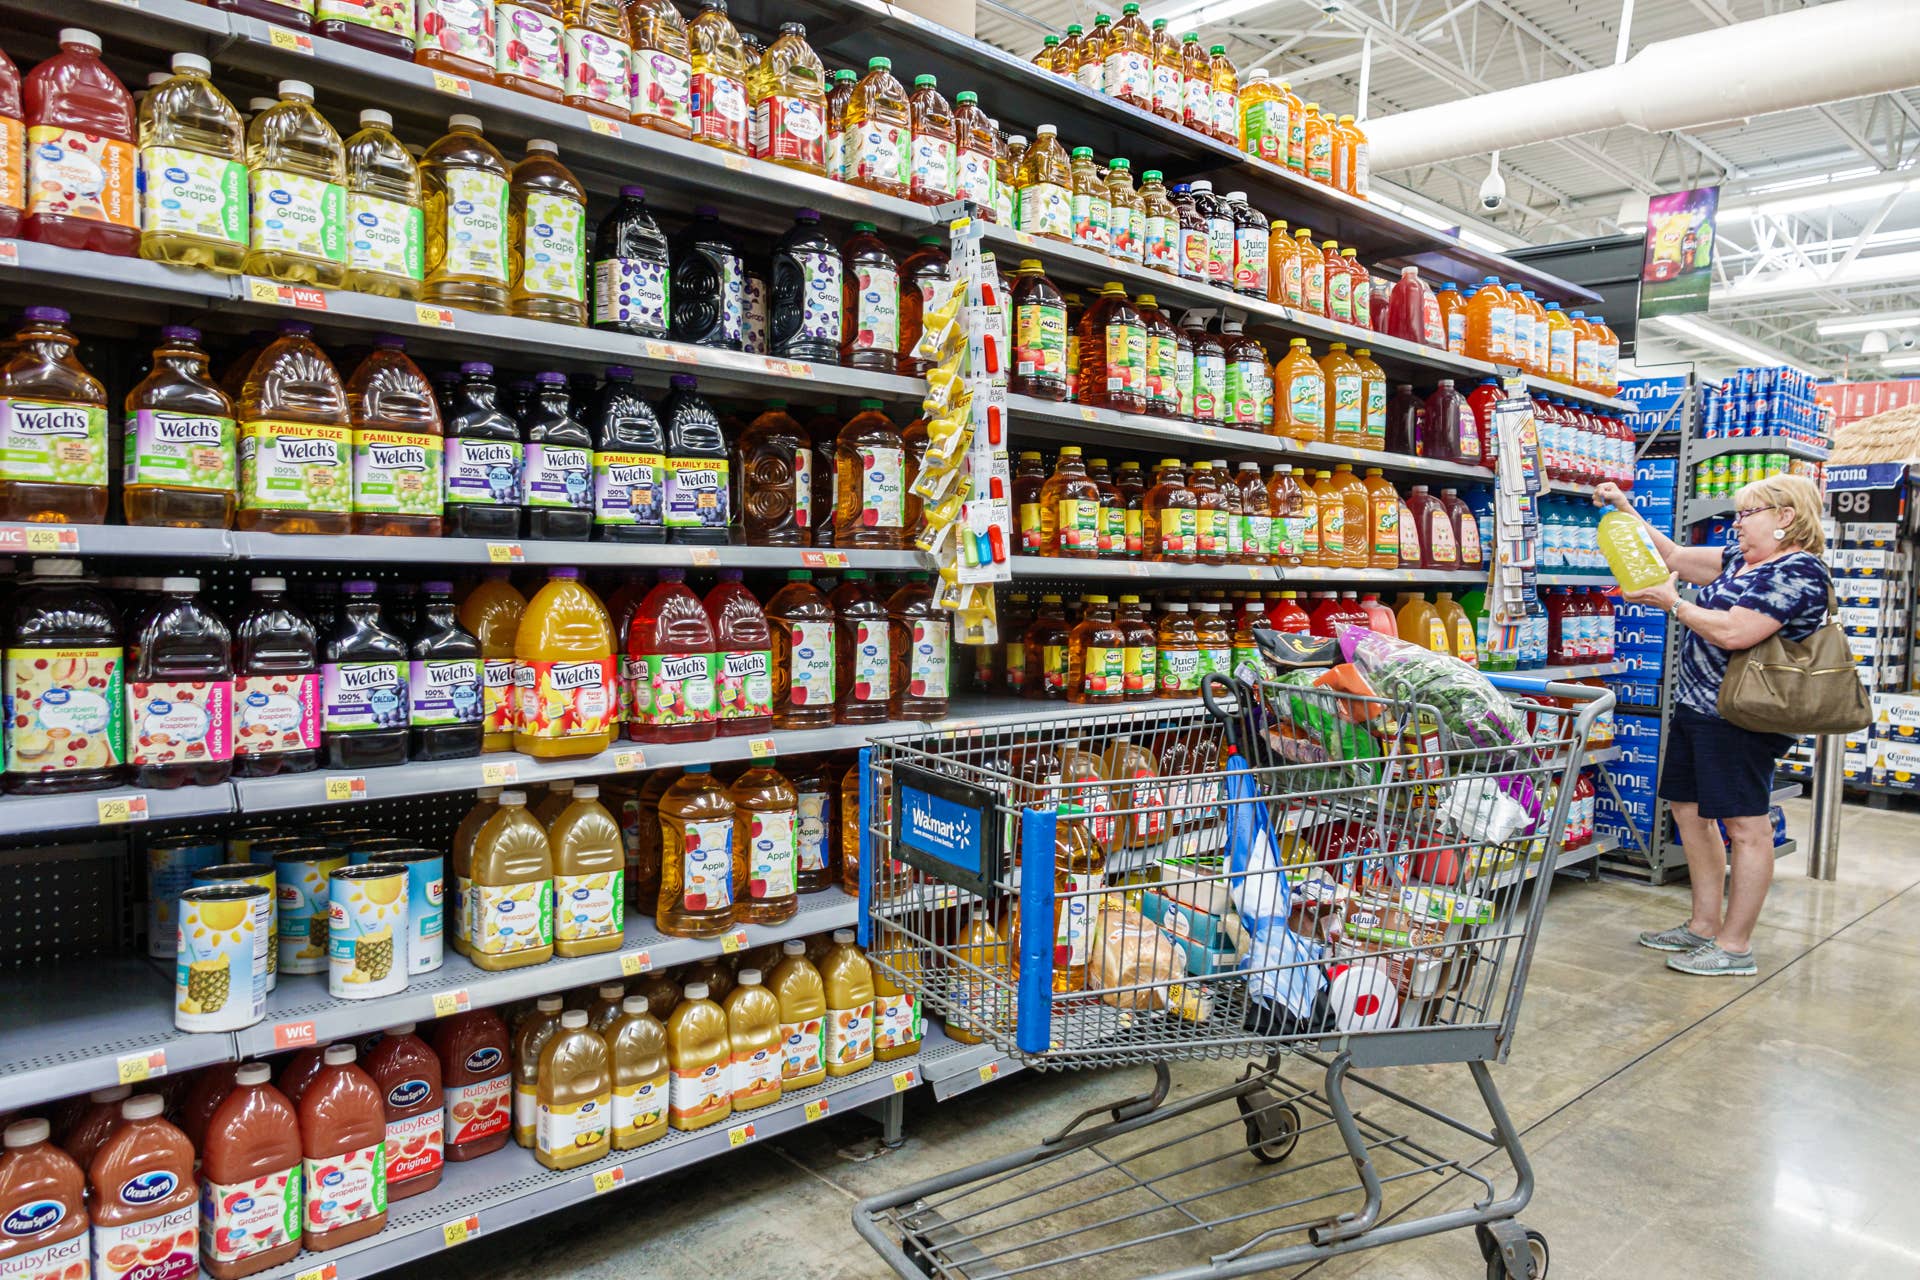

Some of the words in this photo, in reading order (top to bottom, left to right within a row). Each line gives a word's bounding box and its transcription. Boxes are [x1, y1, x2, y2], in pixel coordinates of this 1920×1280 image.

[110, 145, 121, 188] Cocktail
[926, 159, 945, 171] Apple
[194, 183, 216, 193] White
[229, 171, 239, 201] Juice
[173, 186, 216, 203] Grape
[111, 191, 121, 218] Juice
[277, 208, 317, 223] Grape
[463, 217, 498, 231] Grape
[365, 229, 400, 244] Grape
[1212, 230, 1233, 241] Juicy
[542, 239, 574, 254] Grape
[1242, 240, 1266, 251] Juicy
[296, 291, 322, 302] WIC
[638, 288, 662, 301] Grape
[819, 292, 840, 303] Grape
[874, 304, 894, 316] Apple
[985, 322, 1000, 330] CLIPS
[1626, 380, 1667, 399] mini
[16, 411, 86, 430] Welch's
[1623, 411, 1662, 425] mini
[160, 422, 218, 439] Welch's
[269, 425, 312, 437] FAMILY
[316, 429, 343, 440] SIZE
[8, 436, 38, 447] 100%
[363, 433, 403, 444] FAMILY
[407, 436, 430, 446] SIZE
[280, 442, 335, 458] Welch's
[373, 449, 423, 465] Welch's
[465, 447, 511, 462] Welch's
[547, 452, 586, 466] Welch's
[603, 455, 634, 464] FAMILY
[638, 456, 657, 465] SIZE
[671, 460, 701, 469] FAMILY
[704, 461, 721, 470] SIZE
[459, 466, 480, 475] 100%
[612, 466, 652, 481] Welch's
[680, 471, 717, 486] Welch's
[879, 483, 899, 493] Apple
[1838, 492, 1870, 513] 98
[728, 656, 764, 672] Welch's
[808, 658, 829, 669] Apple
[871, 656, 888, 666] Apple
[927, 655, 946, 665] Apple
[1171, 656, 1197, 668] Juicy
[430, 666, 475, 683] Welch's
[488, 669, 515, 682] Welc
[665, 659, 706, 677] Welch's
[1175, 665, 1195, 673] Juice
[344, 668, 396, 686] Welch's
[555, 667, 600, 685] Welch's
[113, 669, 121, 719] Cocktail
[305, 679, 313, 717] Cocktail
[338, 693, 361, 701] 100%
[425, 689, 445, 697] 100%
[53, 705, 97, 716] Cranberry
[214, 687, 223, 727] Cocktail
[1891, 706, 1920, 716] Coron
[71, 712, 98, 722] Apple
[113, 721, 121, 750] Juice
[305, 718, 313, 743] Juice
[214, 728, 223, 754] Juice
[1598, 772, 1640, 788] mini
[103, 804, 125, 817] 298
[1595, 797, 1638, 814] mini
[800, 827, 820, 836] Apple
[1594, 823, 1636, 840] min
[767, 850, 790, 861] Apple
[702, 860, 725, 870] Apple
[576, 899, 609, 910] Pineapple
[502, 911, 535, 922] Pineapple
[285, 1025, 312, 1038] WIC
[792, 1043, 816, 1053] Orange
[467, 1056, 483, 1069] Ocean
[482, 1053, 499, 1066] Spray
[391, 1088, 409, 1103] Ocean
[408, 1084, 427, 1101] Spray
[471, 1115, 502, 1133] Original
[377, 1150, 385, 1177] Juice
[396, 1153, 431, 1173] Original
[125, 1183, 150, 1199] Ocean
[149, 1178, 172, 1197] Spray
[289, 1174, 299, 1202] Juice
[329, 1182, 368, 1200] Grapefruit
[377, 1179, 385, 1206] 100%
[6, 1213, 34, 1229] Ocean
[33, 1208, 57, 1226] Spray
[238, 1209, 279, 1226] Grapefruit
[288, 1204, 299, 1234] 100%
[130, 1261, 161, 1280] 100%
